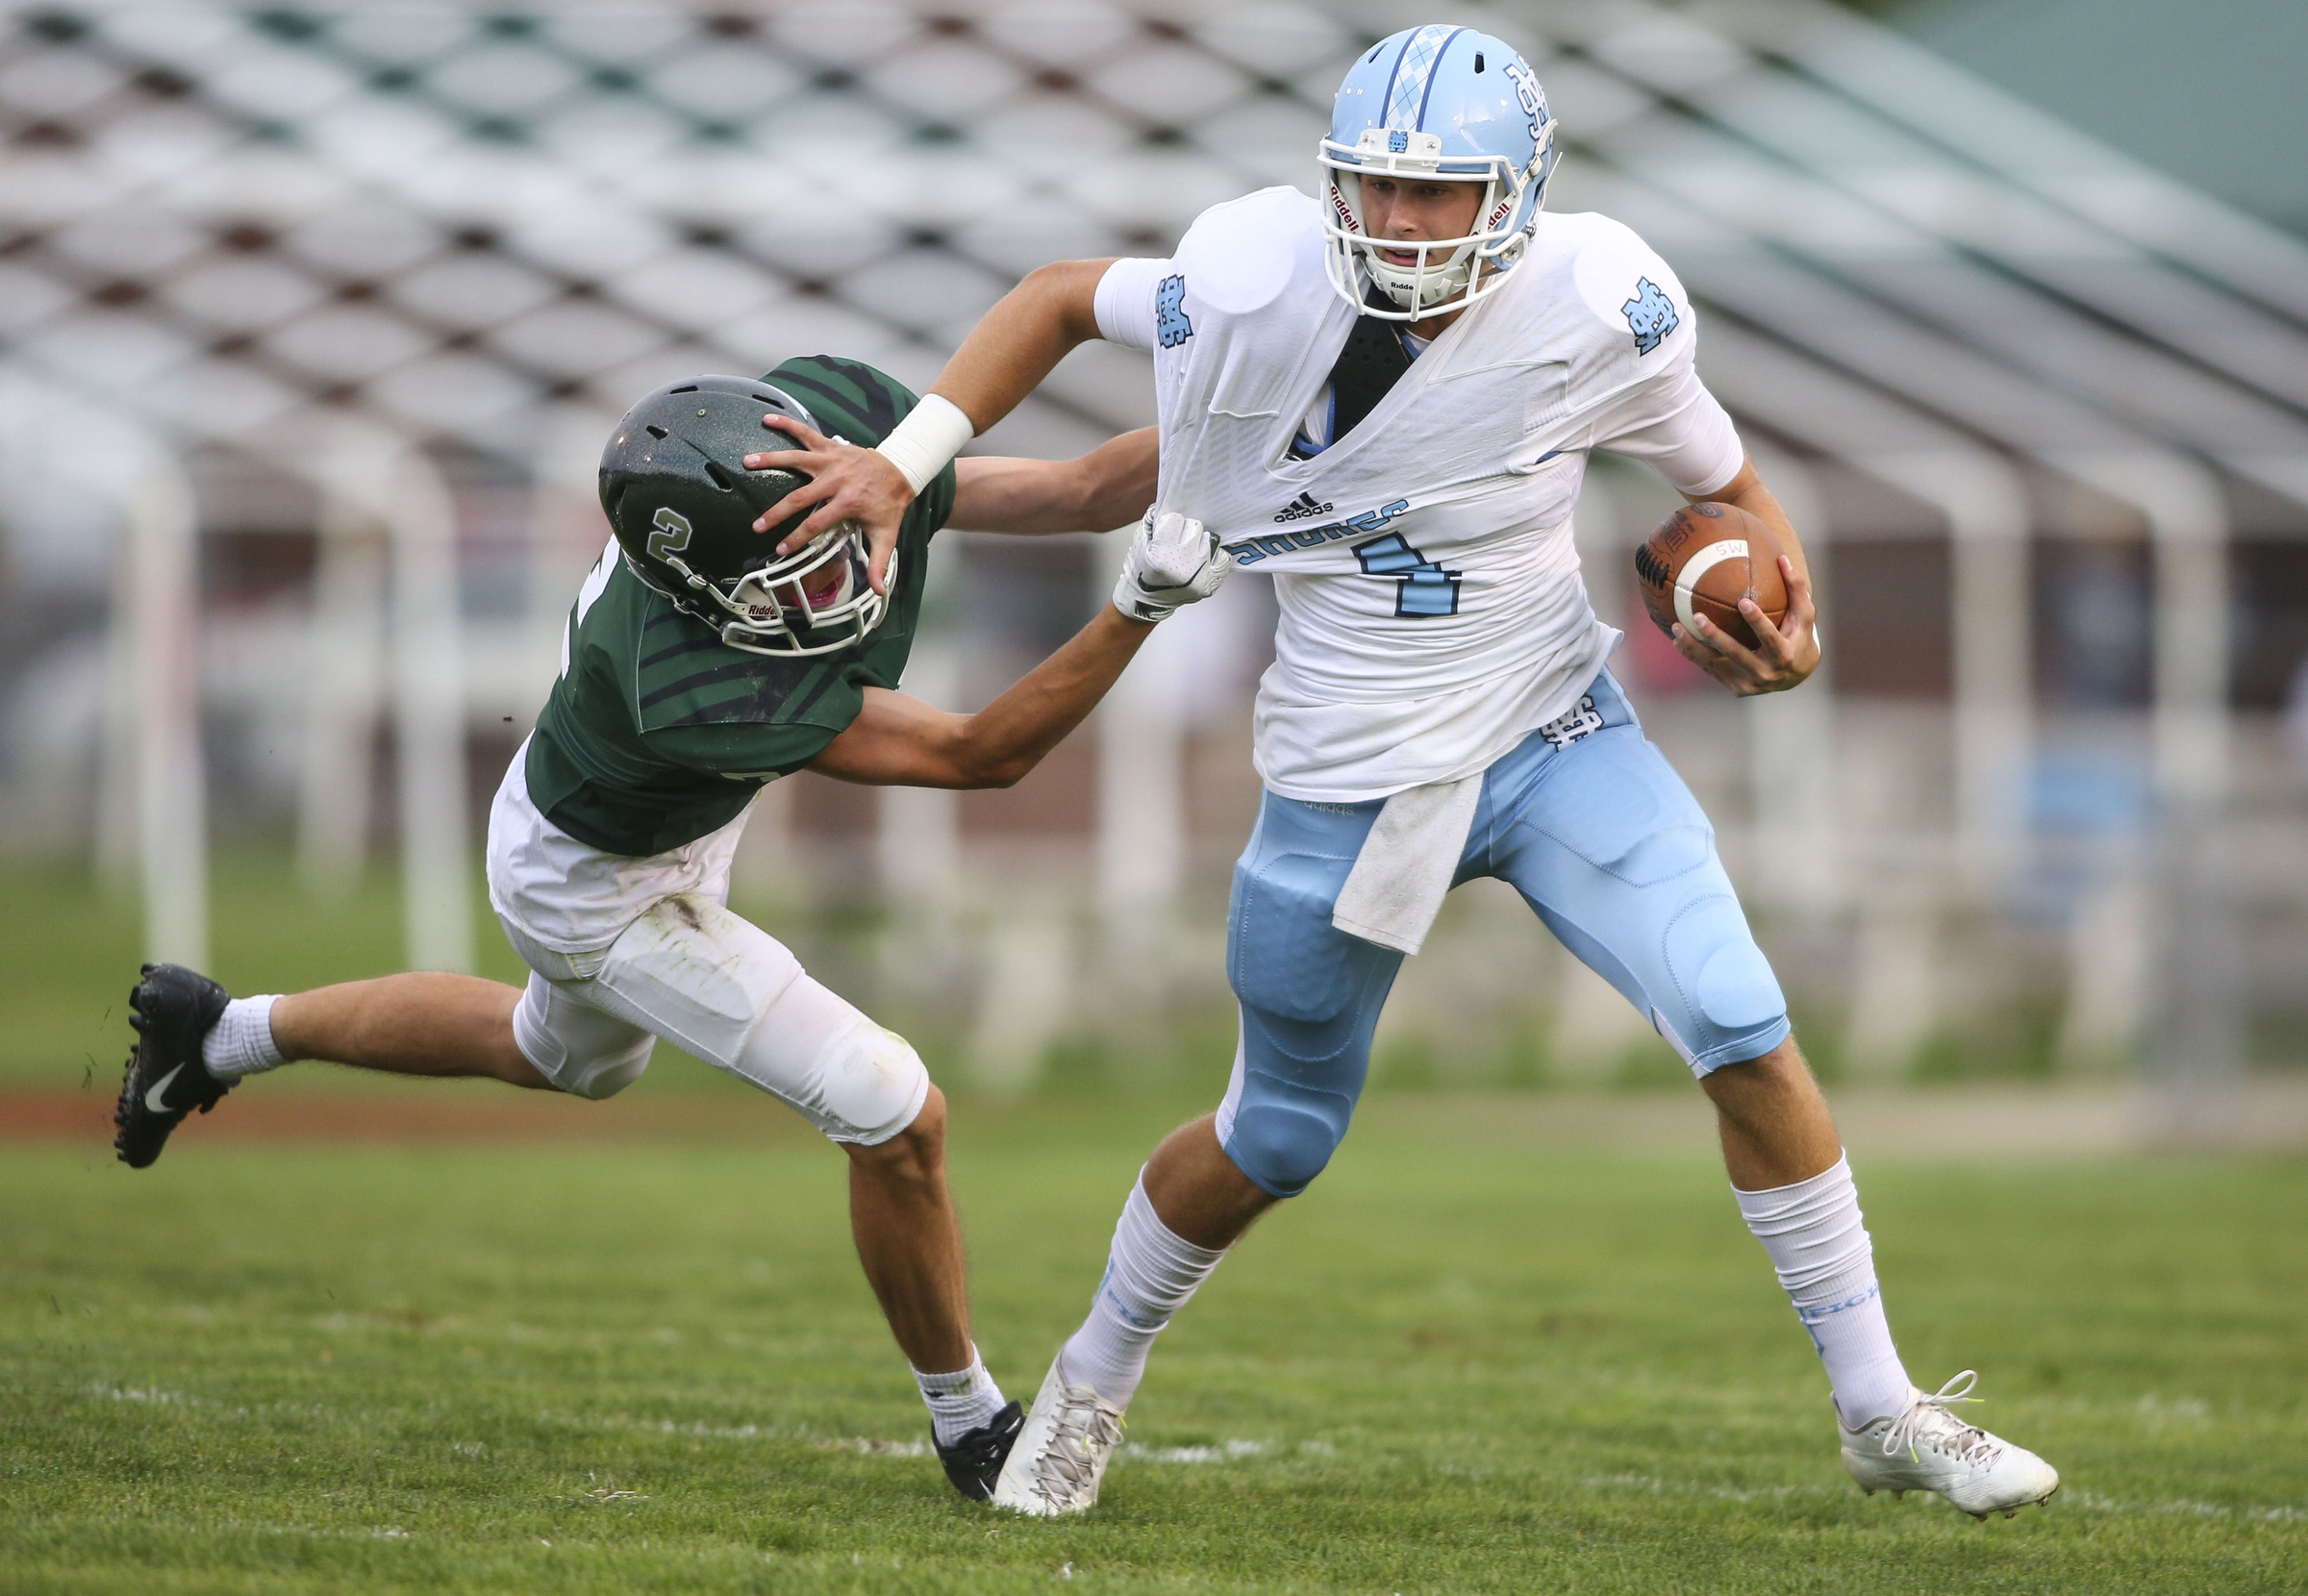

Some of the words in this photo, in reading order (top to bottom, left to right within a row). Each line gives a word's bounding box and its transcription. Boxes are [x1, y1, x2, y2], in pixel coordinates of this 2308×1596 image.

[1331, 186, 1360, 232] Riddell
[1273, 502, 1334, 523] adidas
[646, 507, 692, 565] 2
